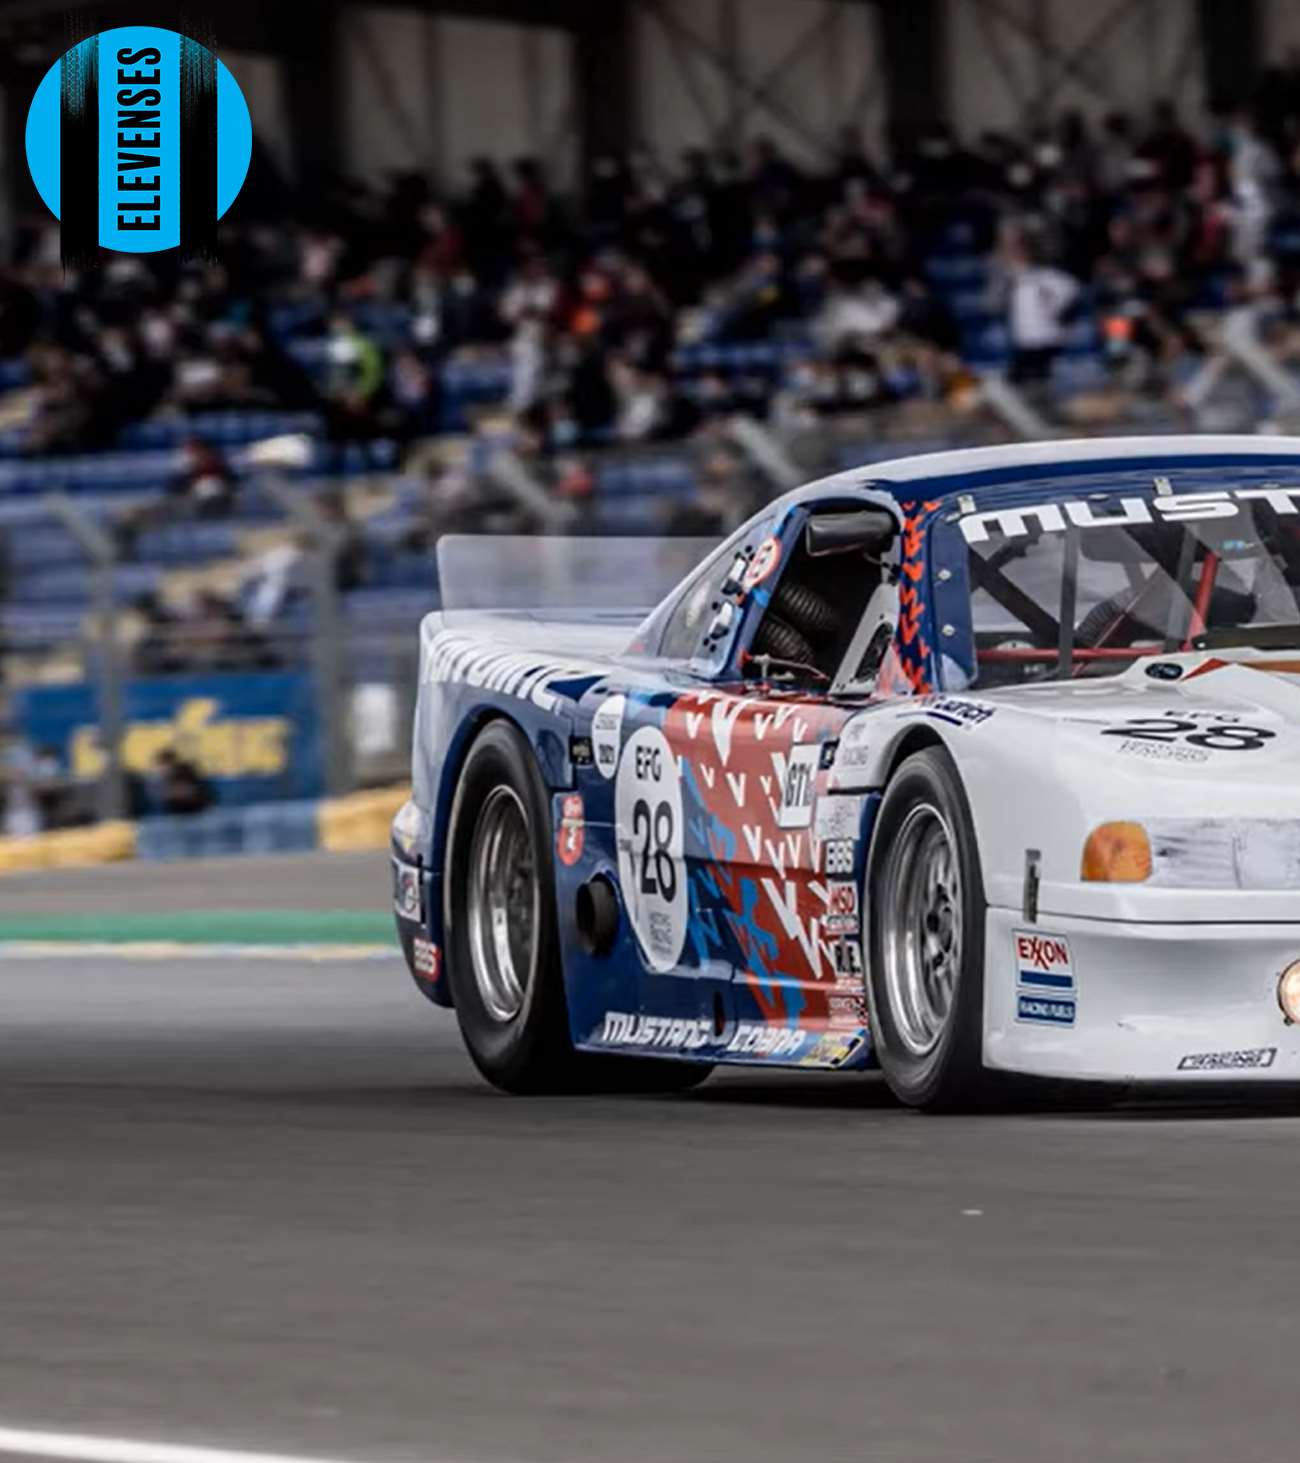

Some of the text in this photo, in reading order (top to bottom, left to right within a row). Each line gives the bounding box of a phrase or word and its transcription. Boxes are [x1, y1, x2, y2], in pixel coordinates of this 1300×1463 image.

[1100, 718, 1277, 751] 28
[635, 745, 662, 783] EFG
[632, 798, 677, 904] 28
[1017, 935, 1069, 971] EXXON
[602, 1011, 711, 1048] MUSTANG
[727, 1025, 806, 1055] COBRA
